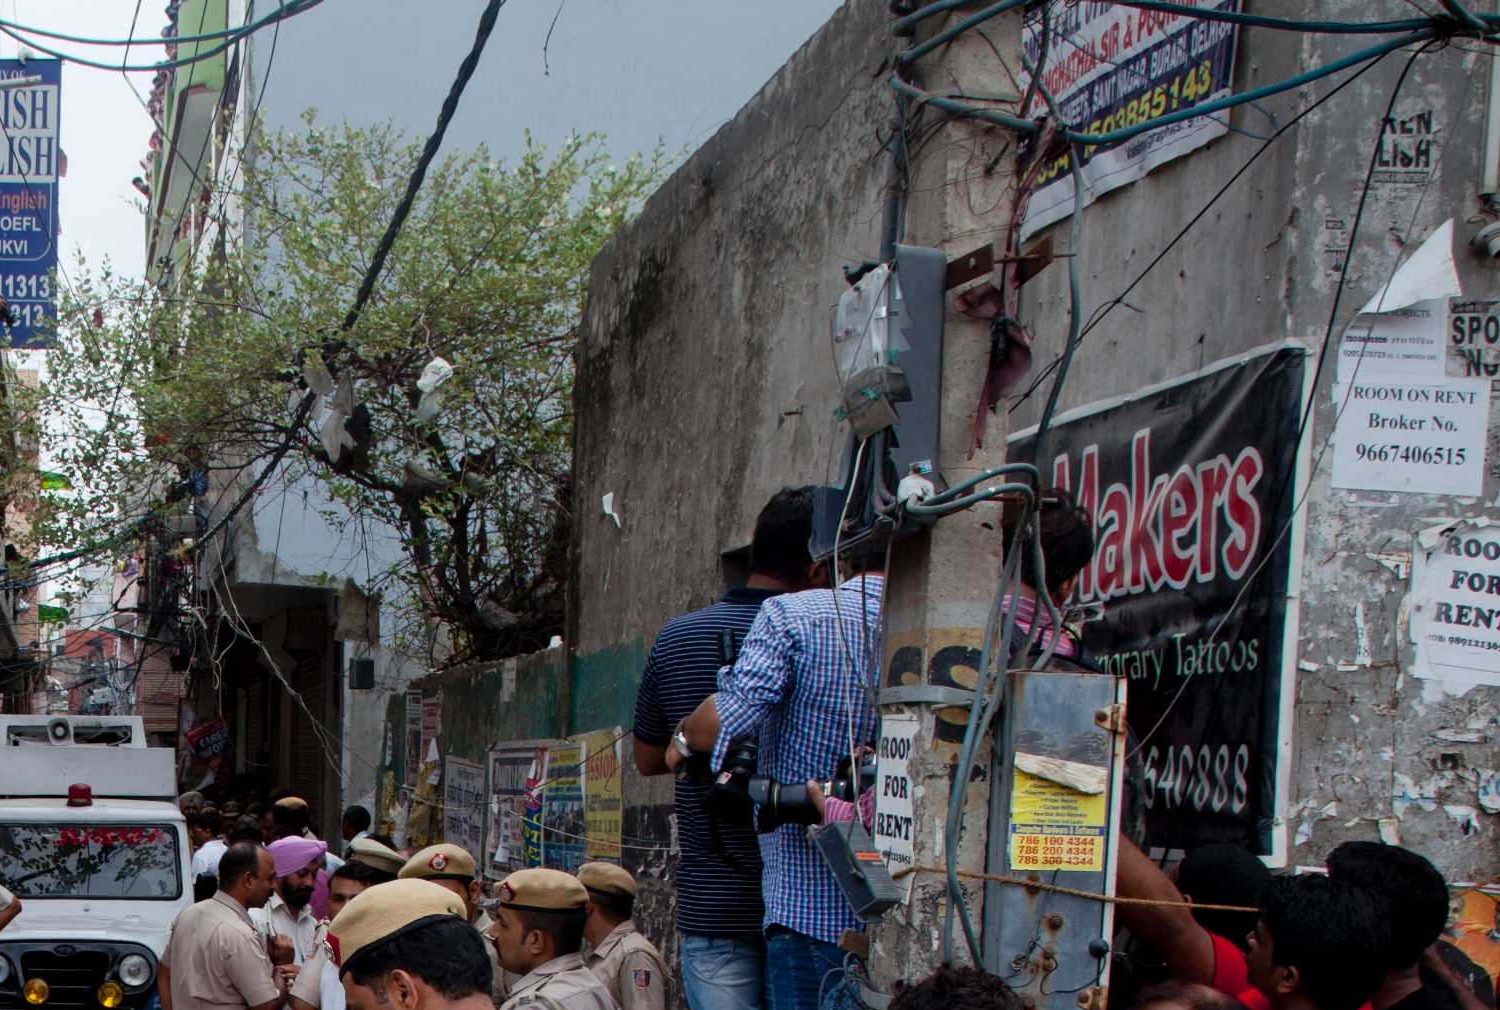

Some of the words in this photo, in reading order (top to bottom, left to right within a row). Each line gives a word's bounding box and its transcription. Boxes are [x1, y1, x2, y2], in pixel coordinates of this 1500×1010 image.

[1101, 22, 1119, 60] SIR
[1124, 14, 1132, 49] &
[1092, 75, 1117, 113] SANT
[1452, 315, 1500, 345] SPO
[1354, 386, 1404, 401] ROOM
[1407, 388, 1431, 402] ON
[1434, 390, 1478, 405] RENT
[1369, 412, 1426, 430] Broker
[1432, 416, 1459, 432] No.
[1356, 443, 1466, 466] 9667406515
[1052, 428, 1264, 600] Makers
[1445, 536, 1500, 561] ROO
[1450, 570, 1500, 595] FOR
[1172, 632, 1259, 676] Tattoos
[884, 775, 908, 799] FOR
[876, 813, 912, 840] RENT
[1018, 845, 1039, 855] 786
[1042, 846, 1063, 855] 200
[1066, 847, 1094, 856] 4344
[1019, 835, 1040, 845] 786
[1044, 837, 1063, 846] 100
[1067, 838, 1095, 847] 4344
[1018, 855, 1038, 865] 786
[1042, 856, 1062, 865] 300
[1066, 857, 1093, 866] 4344
